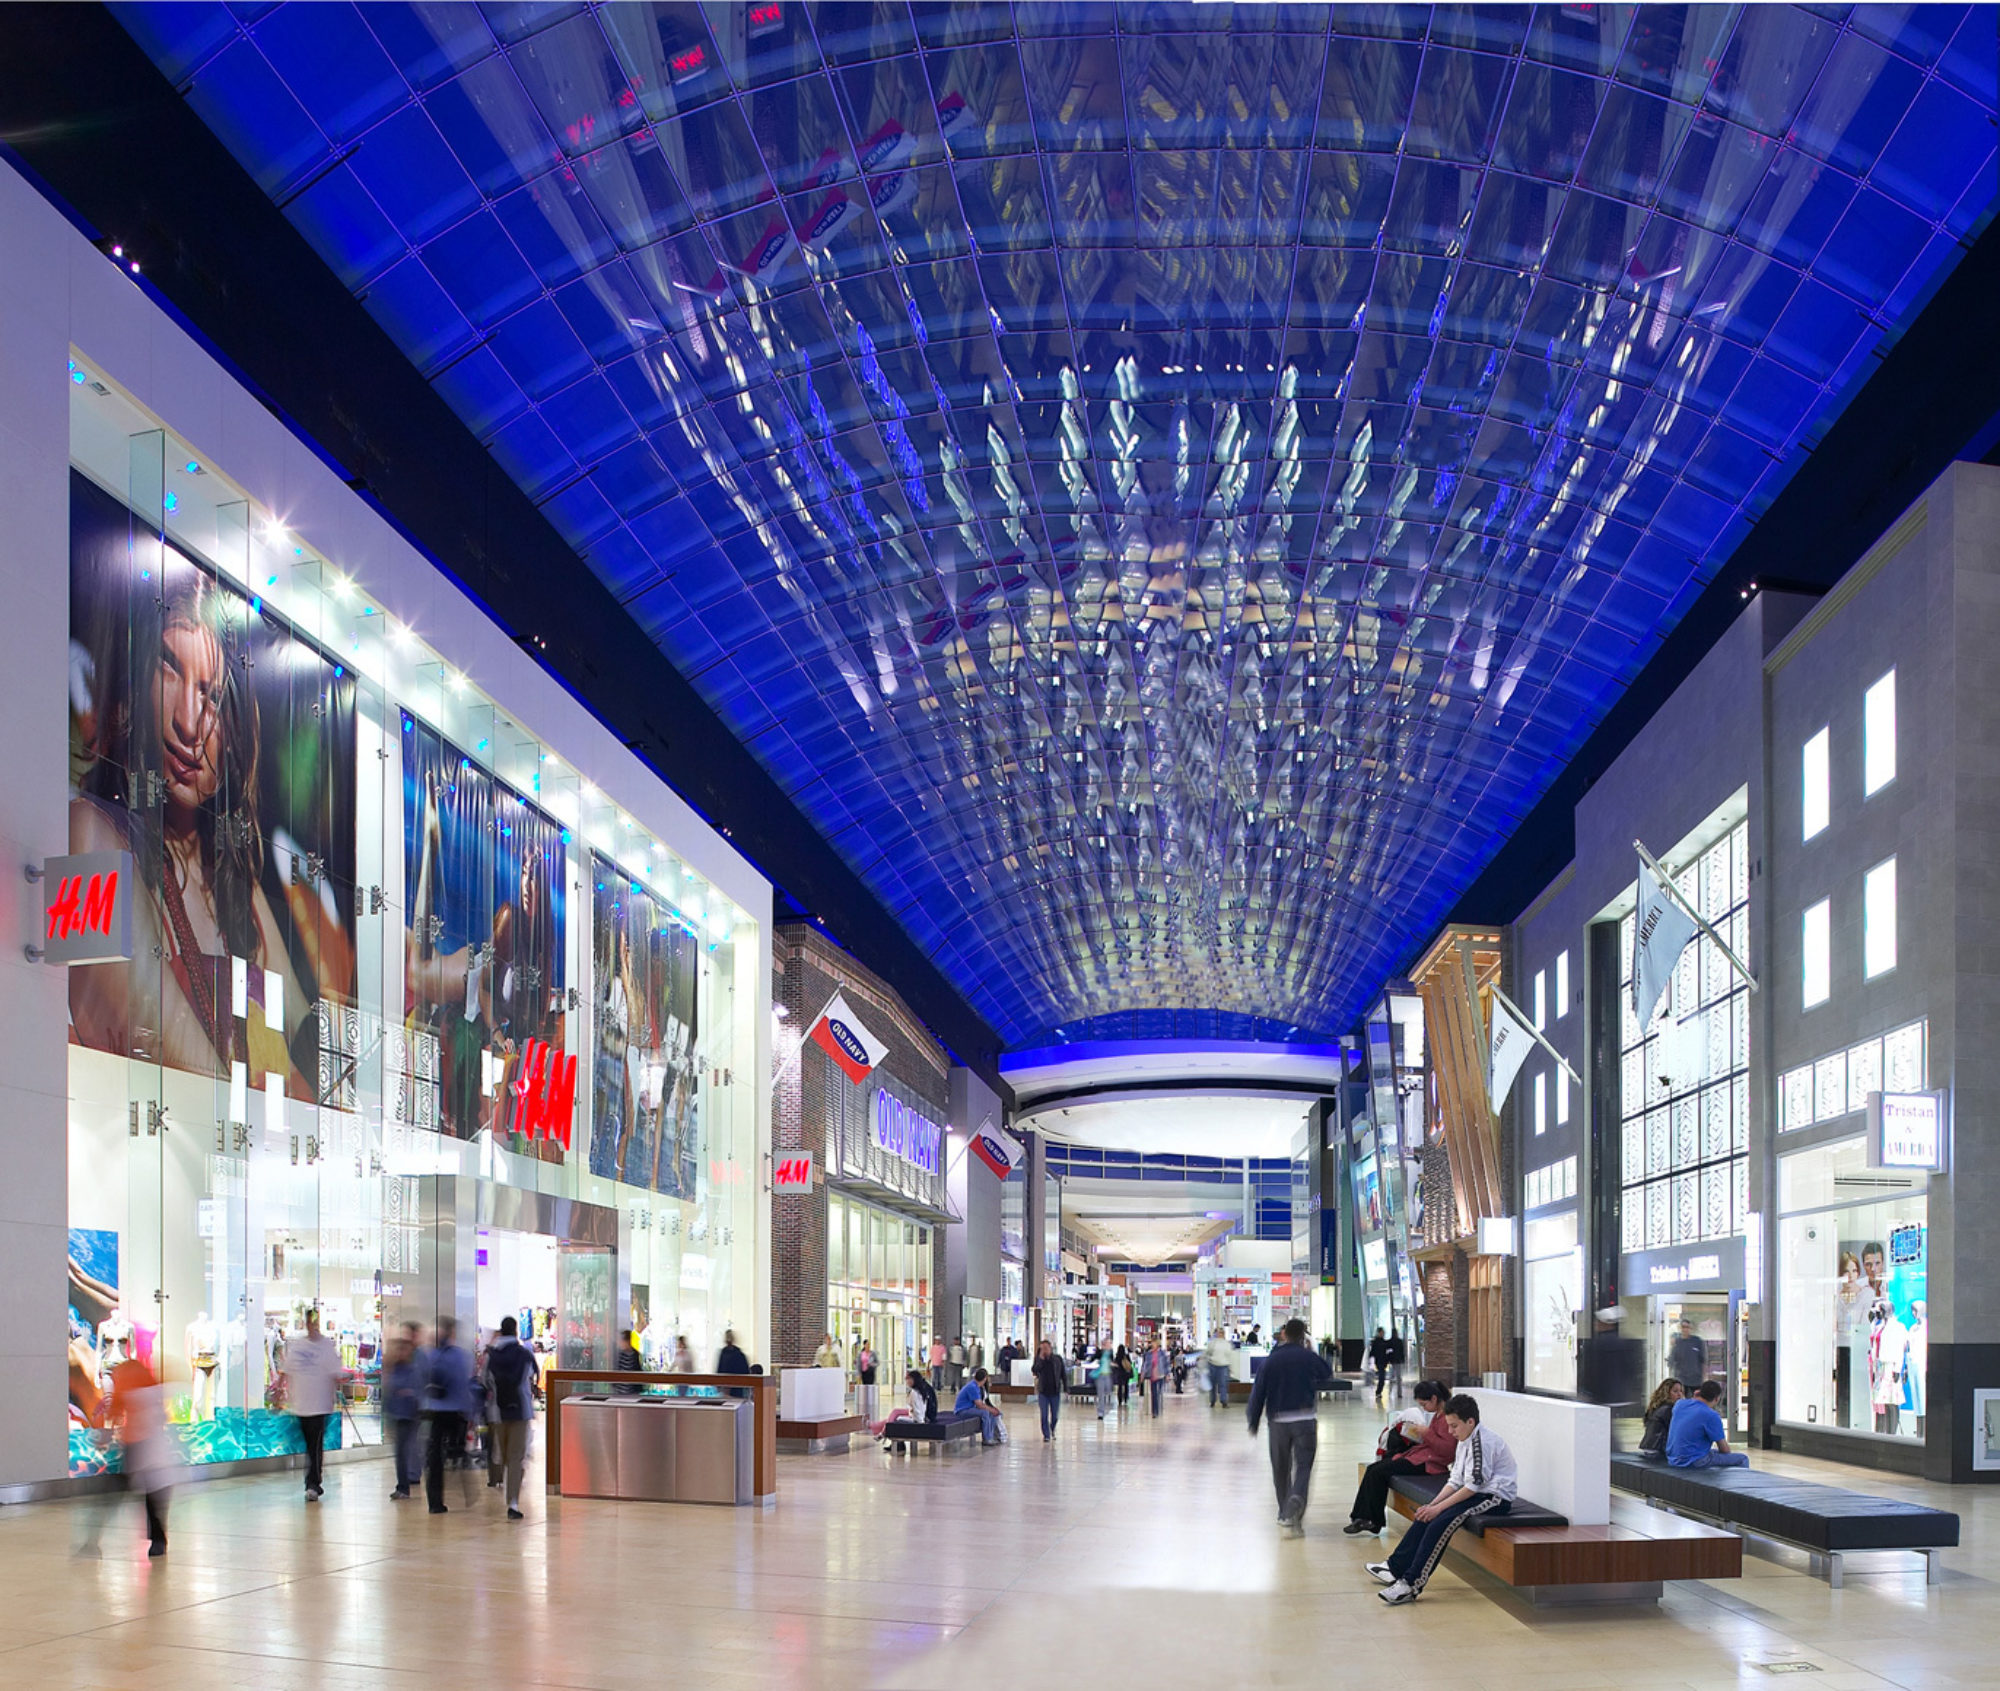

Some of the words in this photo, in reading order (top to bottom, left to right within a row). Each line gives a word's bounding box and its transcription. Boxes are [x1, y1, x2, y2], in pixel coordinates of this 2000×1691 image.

[46, 870, 119, 940] H&M
[832, 1022, 847, 1040] OLD
[844, 1037, 867, 1062] NAVY
[512, 1036, 578, 1151] H&M
[1885, 1103, 1934, 1118] Tristan
[878, 1087, 904, 1155] OLD
[907, 1106, 941, 1175] NAVY
[775, 1159, 810, 1185] H&M
